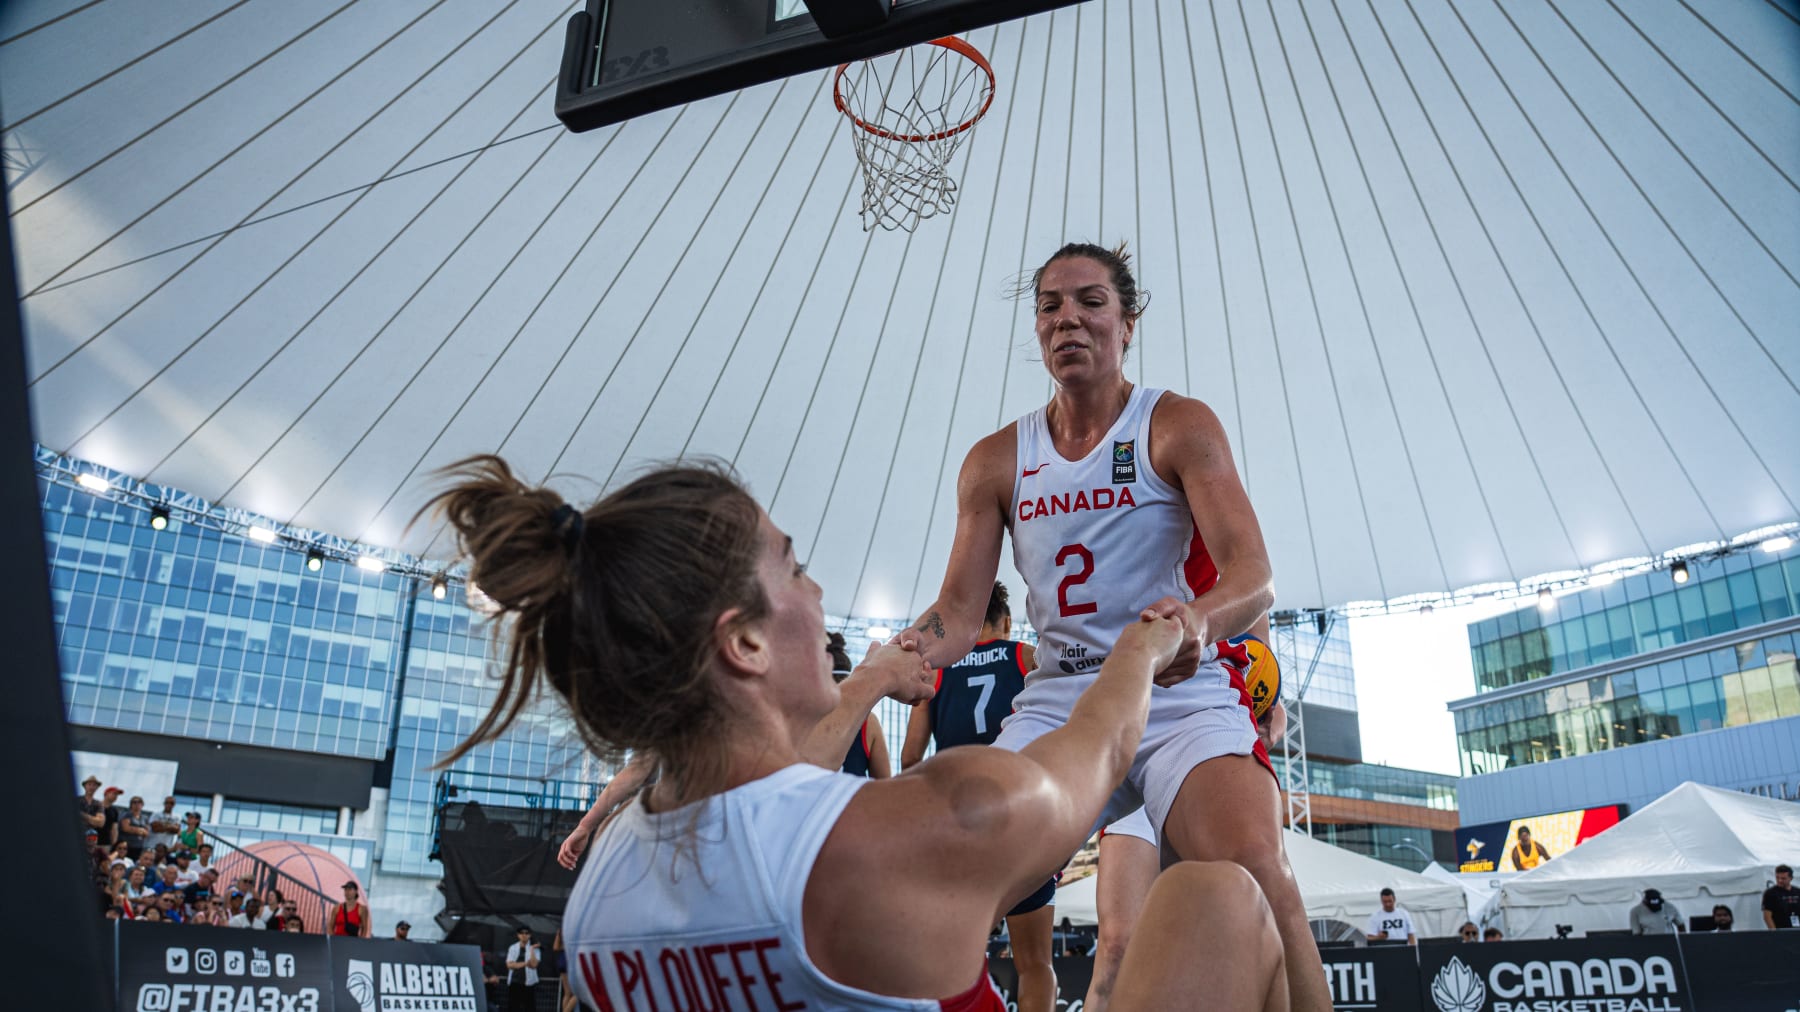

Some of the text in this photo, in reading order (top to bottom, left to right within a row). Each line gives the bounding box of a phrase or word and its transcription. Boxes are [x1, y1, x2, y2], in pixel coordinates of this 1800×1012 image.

[1115, 466, 1133, 474] FIBA
[1019, 487, 1137, 522] CANADA
[1055, 543, 1098, 618] 2
[951, 647, 1009, 669] URDICK
[967, 674, 996, 734] 7
[380, 962, 475, 996] ALBERTA
[1488, 956, 1678, 999] CANADA
[136, 983, 320, 1012] @FIBA3x3
[383, 999, 475, 1011] BASKETBALL
[1493, 997, 1681, 1012] BASKETBALL
